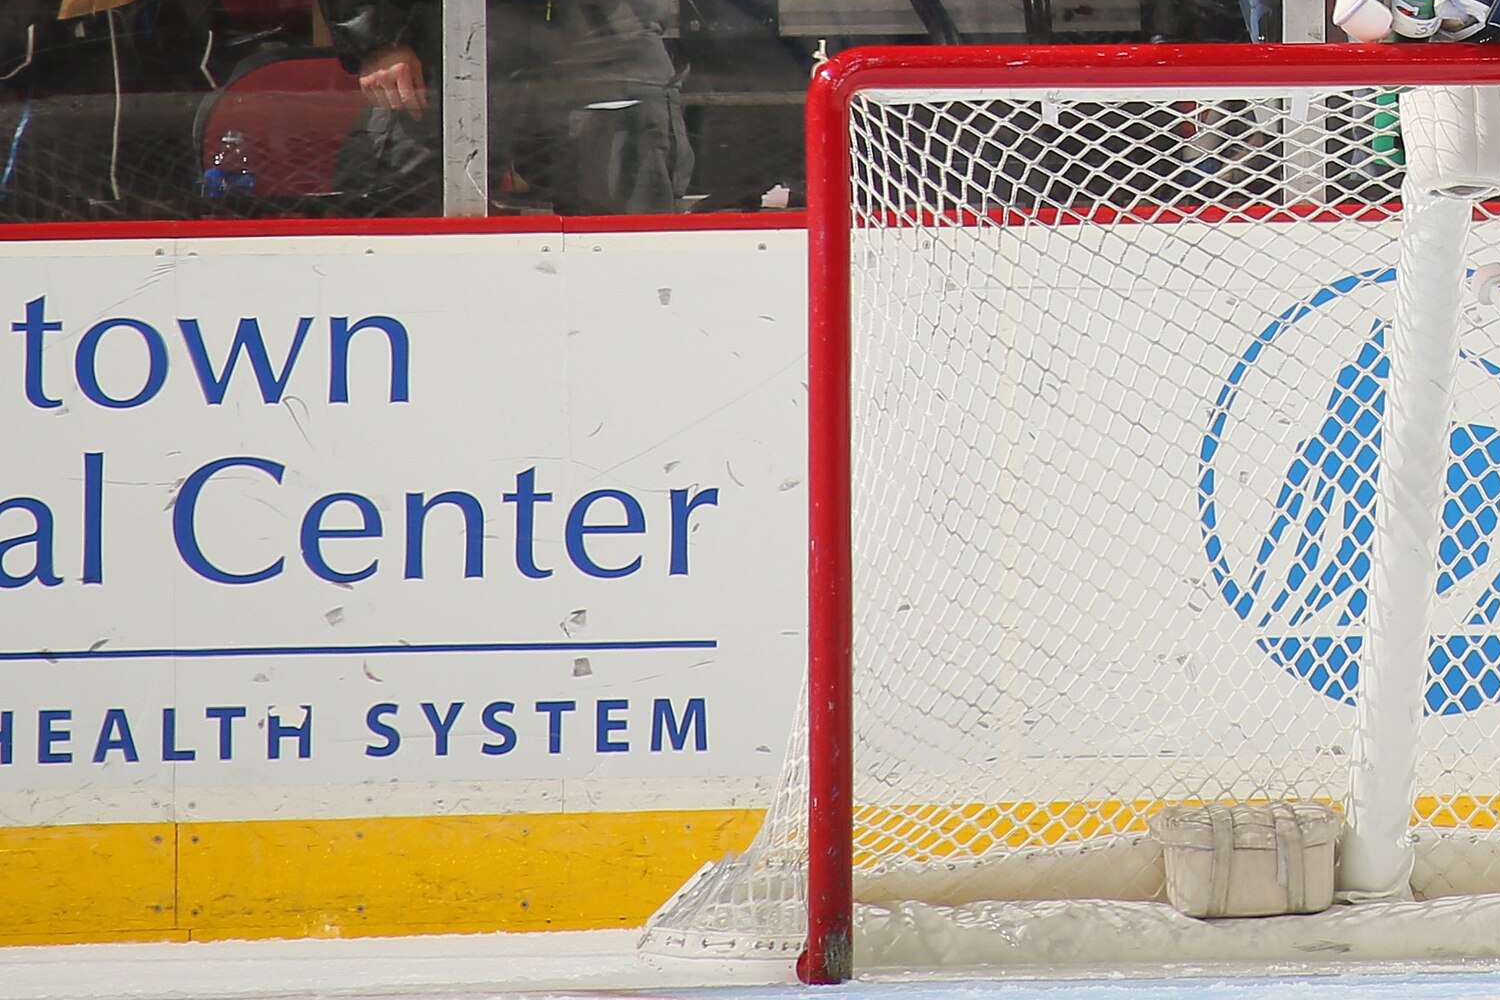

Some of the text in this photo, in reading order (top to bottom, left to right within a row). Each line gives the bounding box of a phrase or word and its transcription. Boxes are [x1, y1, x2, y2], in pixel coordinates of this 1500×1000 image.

[12, 295, 410, 409] town
[172, 455, 720, 585] Center
[364, 698, 709, 757] SYSTEM
